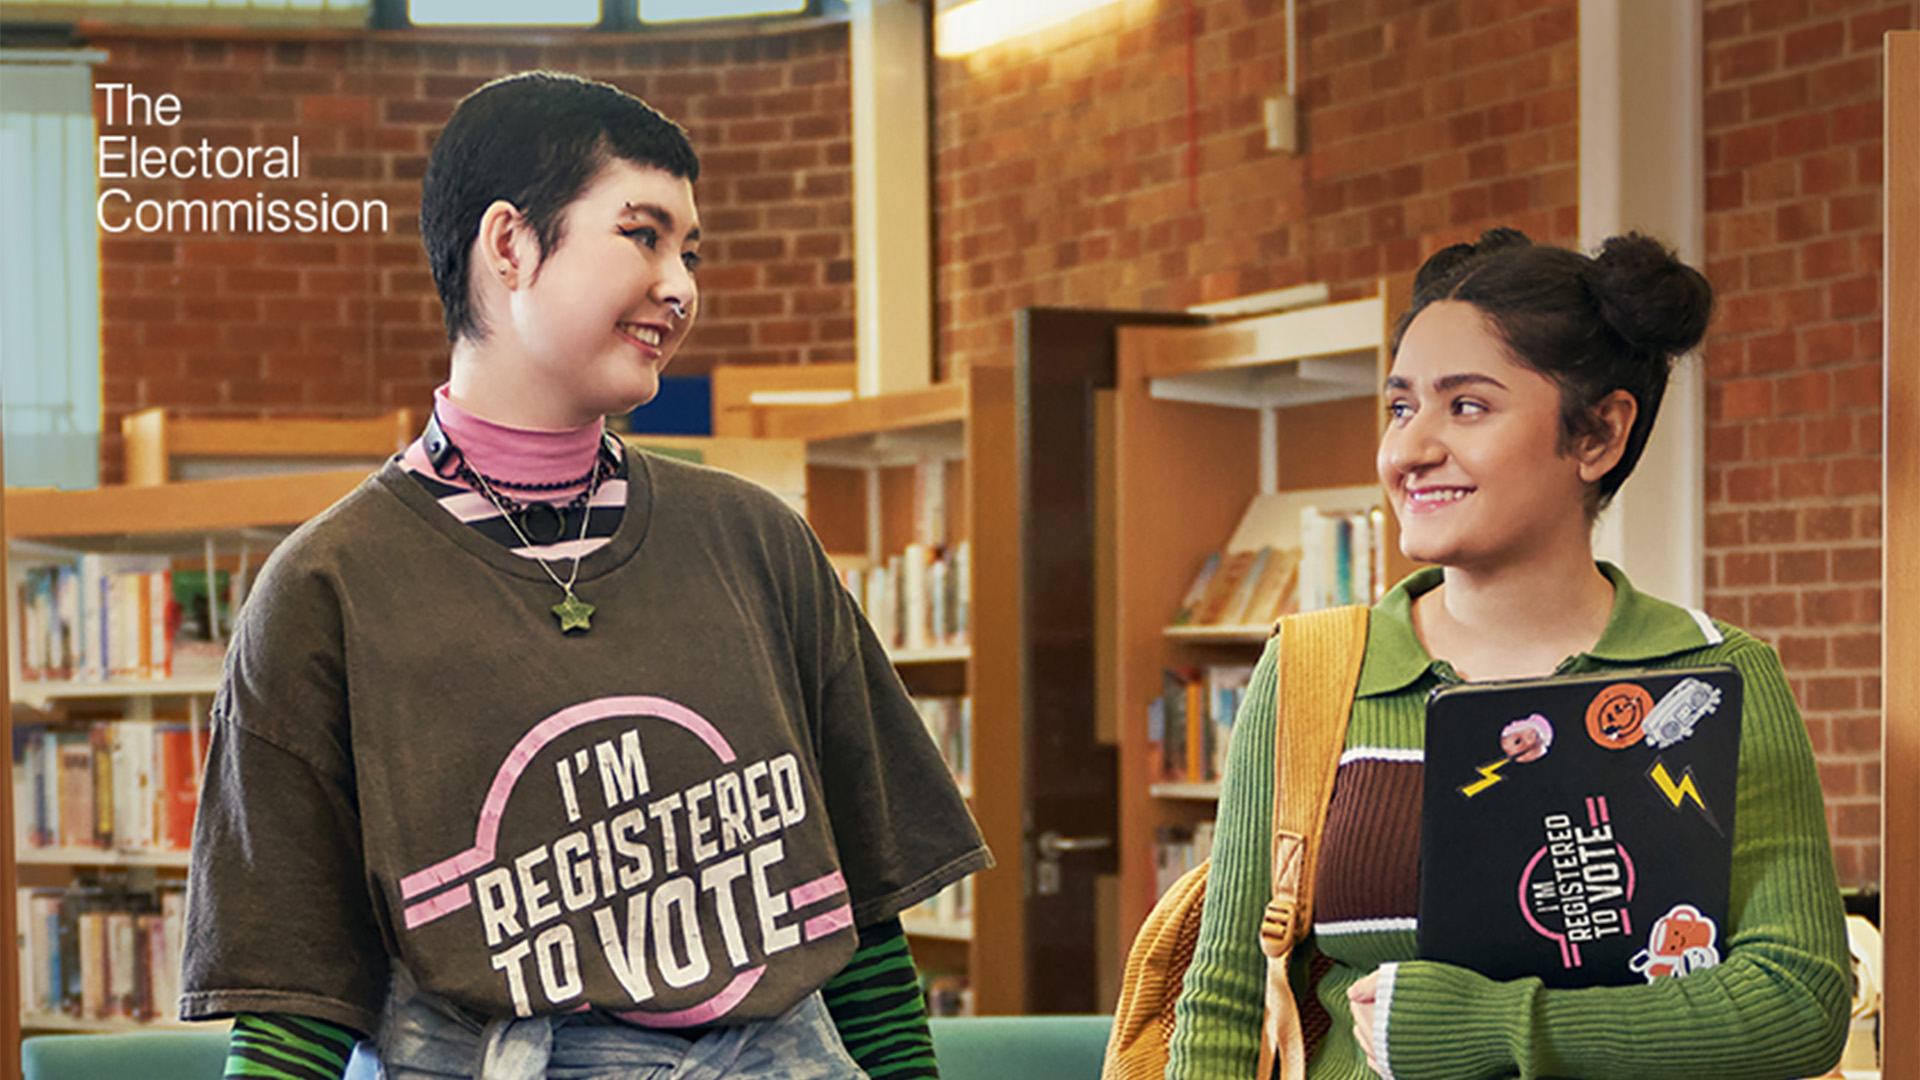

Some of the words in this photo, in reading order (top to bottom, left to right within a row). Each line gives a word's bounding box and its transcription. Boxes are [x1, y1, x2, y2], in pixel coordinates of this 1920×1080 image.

[556, 729, 650, 822] I'M
[476, 753, 806, 946] REGISTERED
[1545, 814, 1593, 941] REGISTERED
[1576, 825, 1623, 903] VOTE
[491, 923, 583, 1017] TO
[593, 839, 800, 1003] VOTE
[1533, 882, 1559, 912] I'M
[1593, 910, 1619, 938] TO
